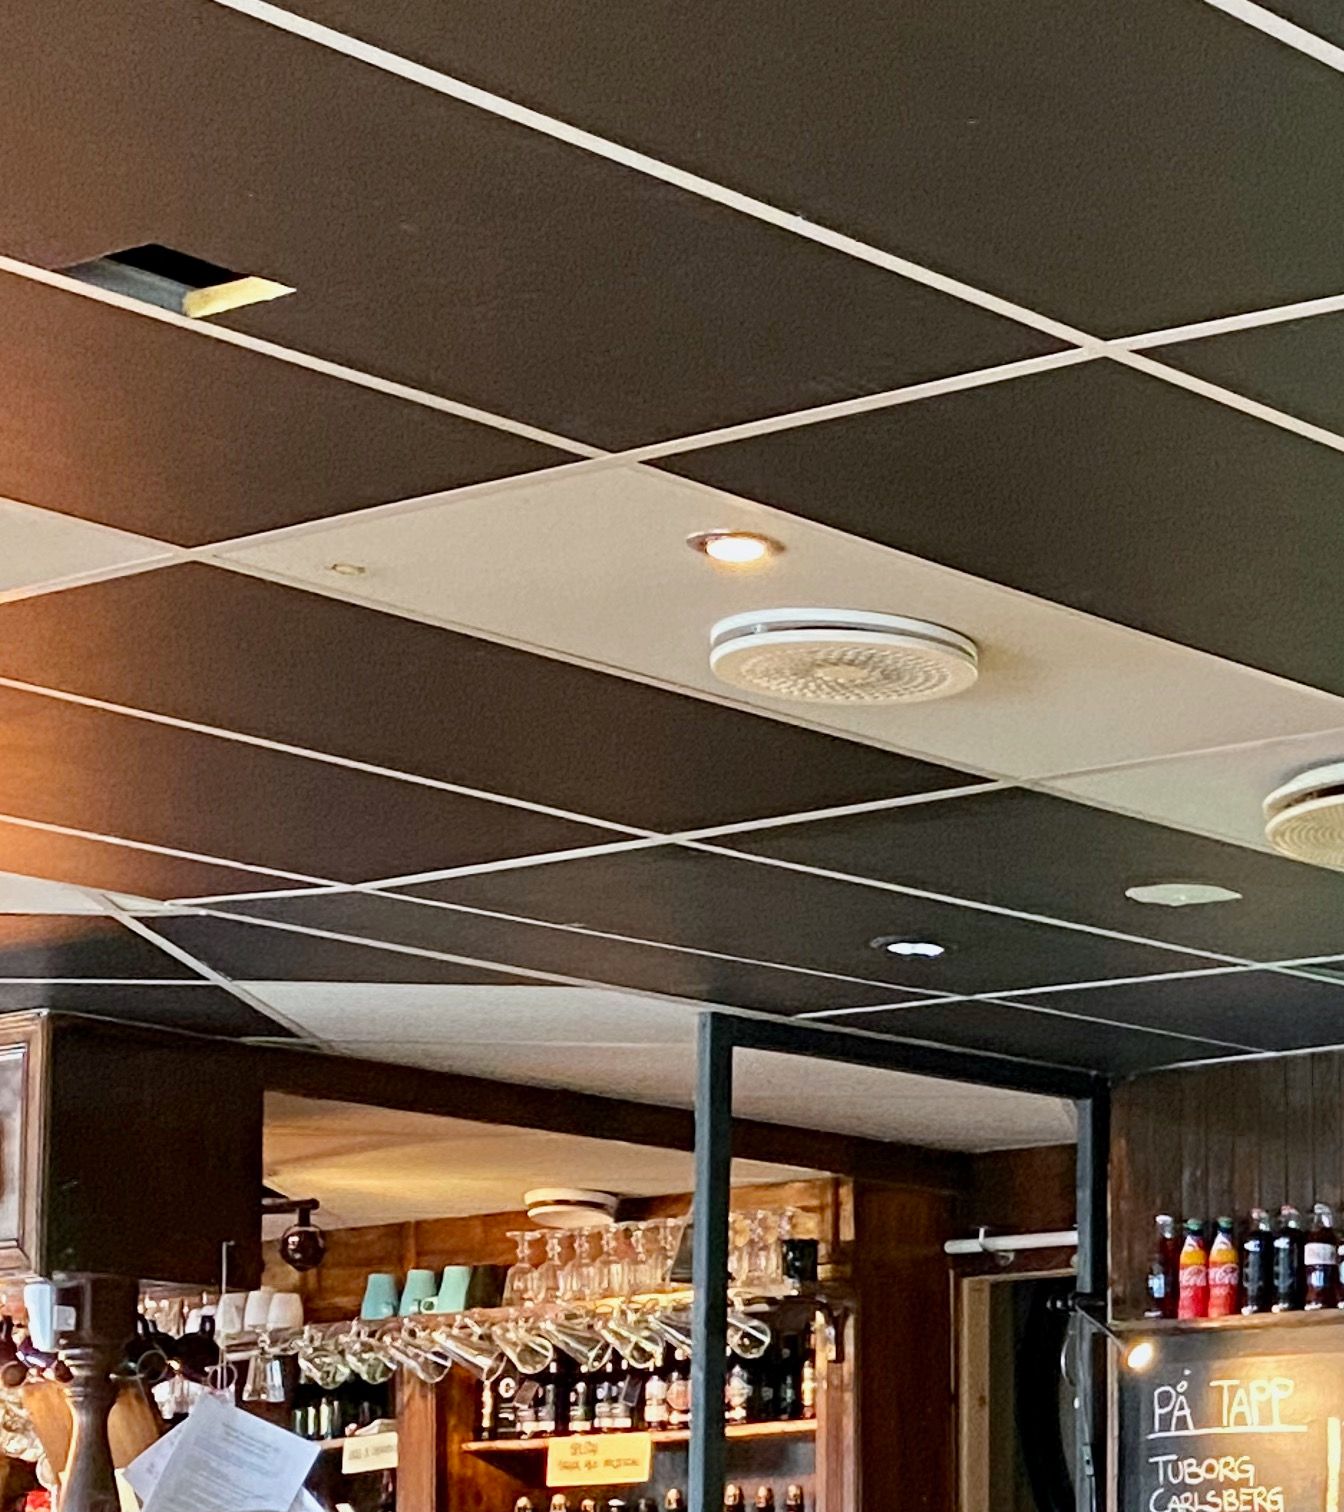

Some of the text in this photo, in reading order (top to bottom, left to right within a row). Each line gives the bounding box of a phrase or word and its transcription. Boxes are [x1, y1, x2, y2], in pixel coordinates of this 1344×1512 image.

[1152, 1376, 1296, 1433] PÅ TAPP
[1148, 1453, 1256, 1487] TUBORG
